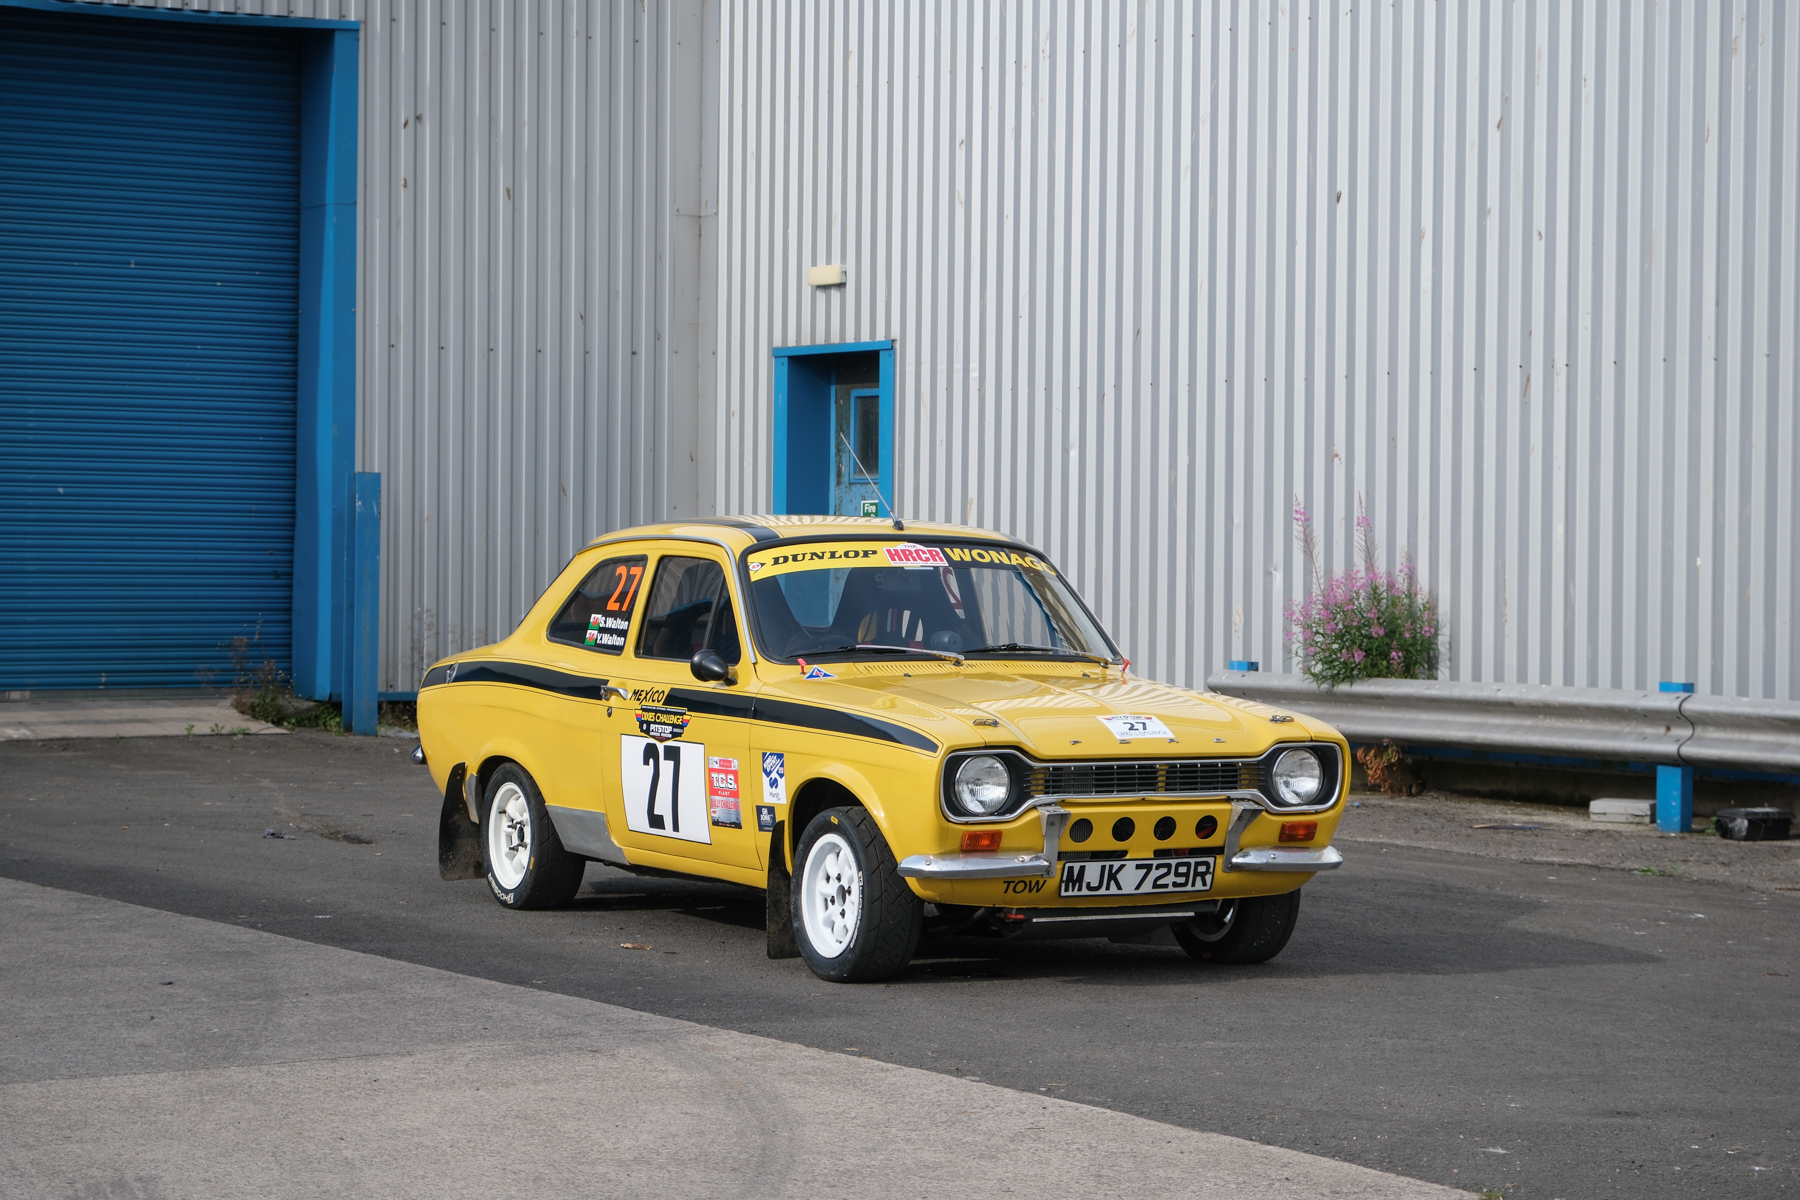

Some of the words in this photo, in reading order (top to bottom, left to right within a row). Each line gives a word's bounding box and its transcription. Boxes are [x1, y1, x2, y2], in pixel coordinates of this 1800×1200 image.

[864, 503, 877, 513] Fire
[771, 549, 878, 567] DUNLOP
[886, 548, 945, 563] HRCR
[943, 547, 1058, 577] WONAGO
[606, 565, 644, 611] 27
[629, 686, 665, 705] MEXICO
[655, 712, 683, 725] CHALLENGE
[1122, 721, 1148, 731] 27
[650, 723, 673, 734] PITSTOP
[643, 742, 681, 833] 27
[720, 799, 740, 811] CHALLENGE
[1064, 863, 1127, 893] MJK
[1133, 860, 1211, 891] 729R
[1002, 879, 1047, 894] TOW
